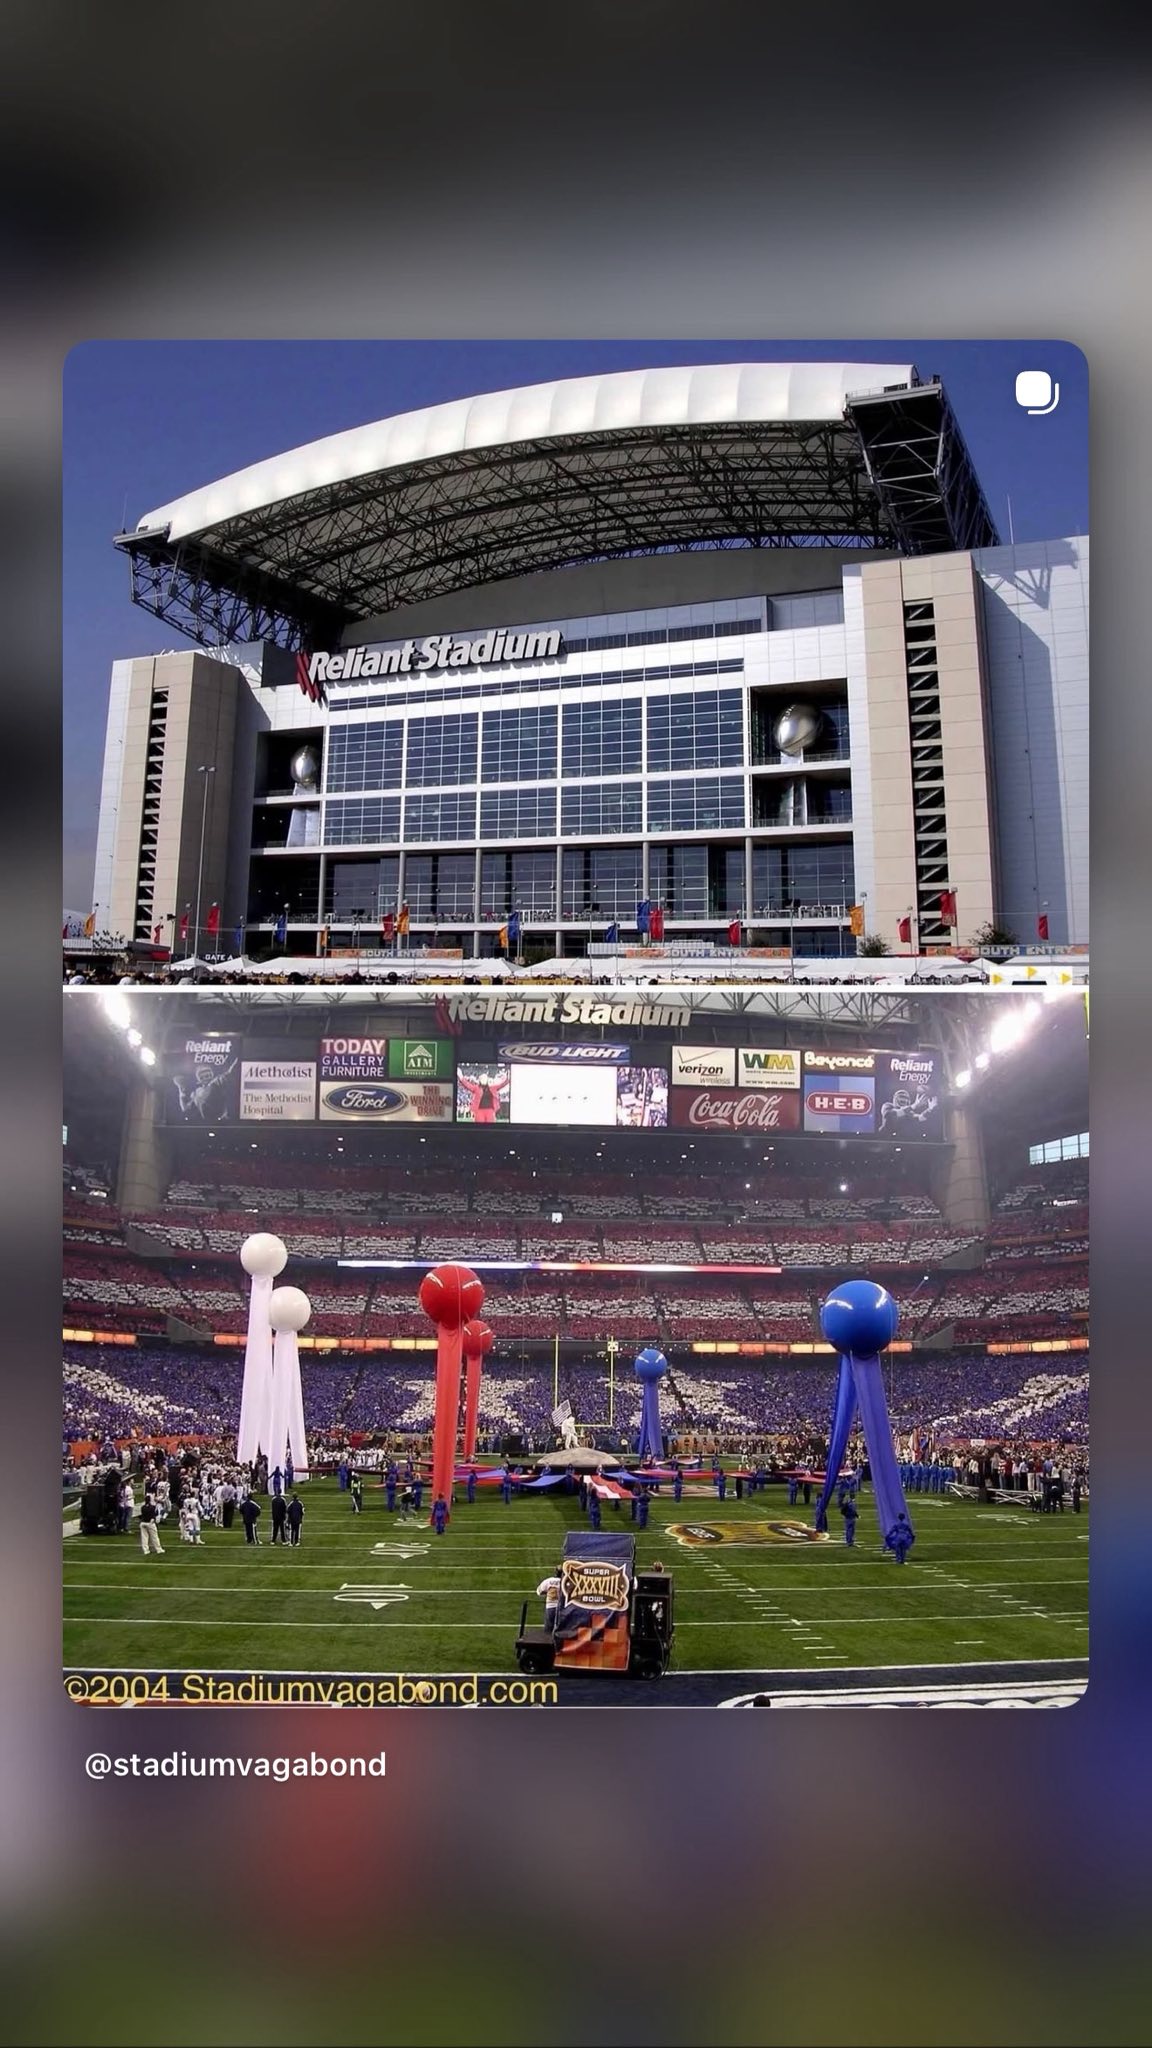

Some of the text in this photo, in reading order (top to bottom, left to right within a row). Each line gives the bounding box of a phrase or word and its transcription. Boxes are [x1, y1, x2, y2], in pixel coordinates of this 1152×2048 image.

[308, 629, 562, 685] Reliant Stadium
[360, 949, 430, 958] SOUTH ENTRY
[664, 949, 750, 958] SOUTH ENTRY
[1027, 945, 1071, 955] ENTRY
[450, 995, 692, 1026] Reliant Stadium
[185, 1040, 232, 1053] Reliant
[322, 1039, 386, 1054] TODAY
[516, 1047, 626, 1059] BUD LIGHT
[194, 1052, 228, 1065] Energy
[322, 1055, 384, 1066] GALLERY
[407, 1058, 433, 1068] AIM
[743, 1053, 794, 1070] WM
[245, 1066, 312, 1078] Methodist
[322, 1066, 384, 1077] FURNITURE
[679, 1063, 724, 1076] verizon
[891, 1059, 933, 1073] Reliant
[899, 1071, 931, 1084] Energy
[244, 1093, 312, 1103] The Methodist
[341, 1089, 387, 1109] Ford
[244, 1105, 284, 1116] Hospital
[689, 1093, 783, 1127] Coca-Cola
[583, 1568, 610, 1576] SUPER
[571, 1574, 620, 1598] XXXVIII
